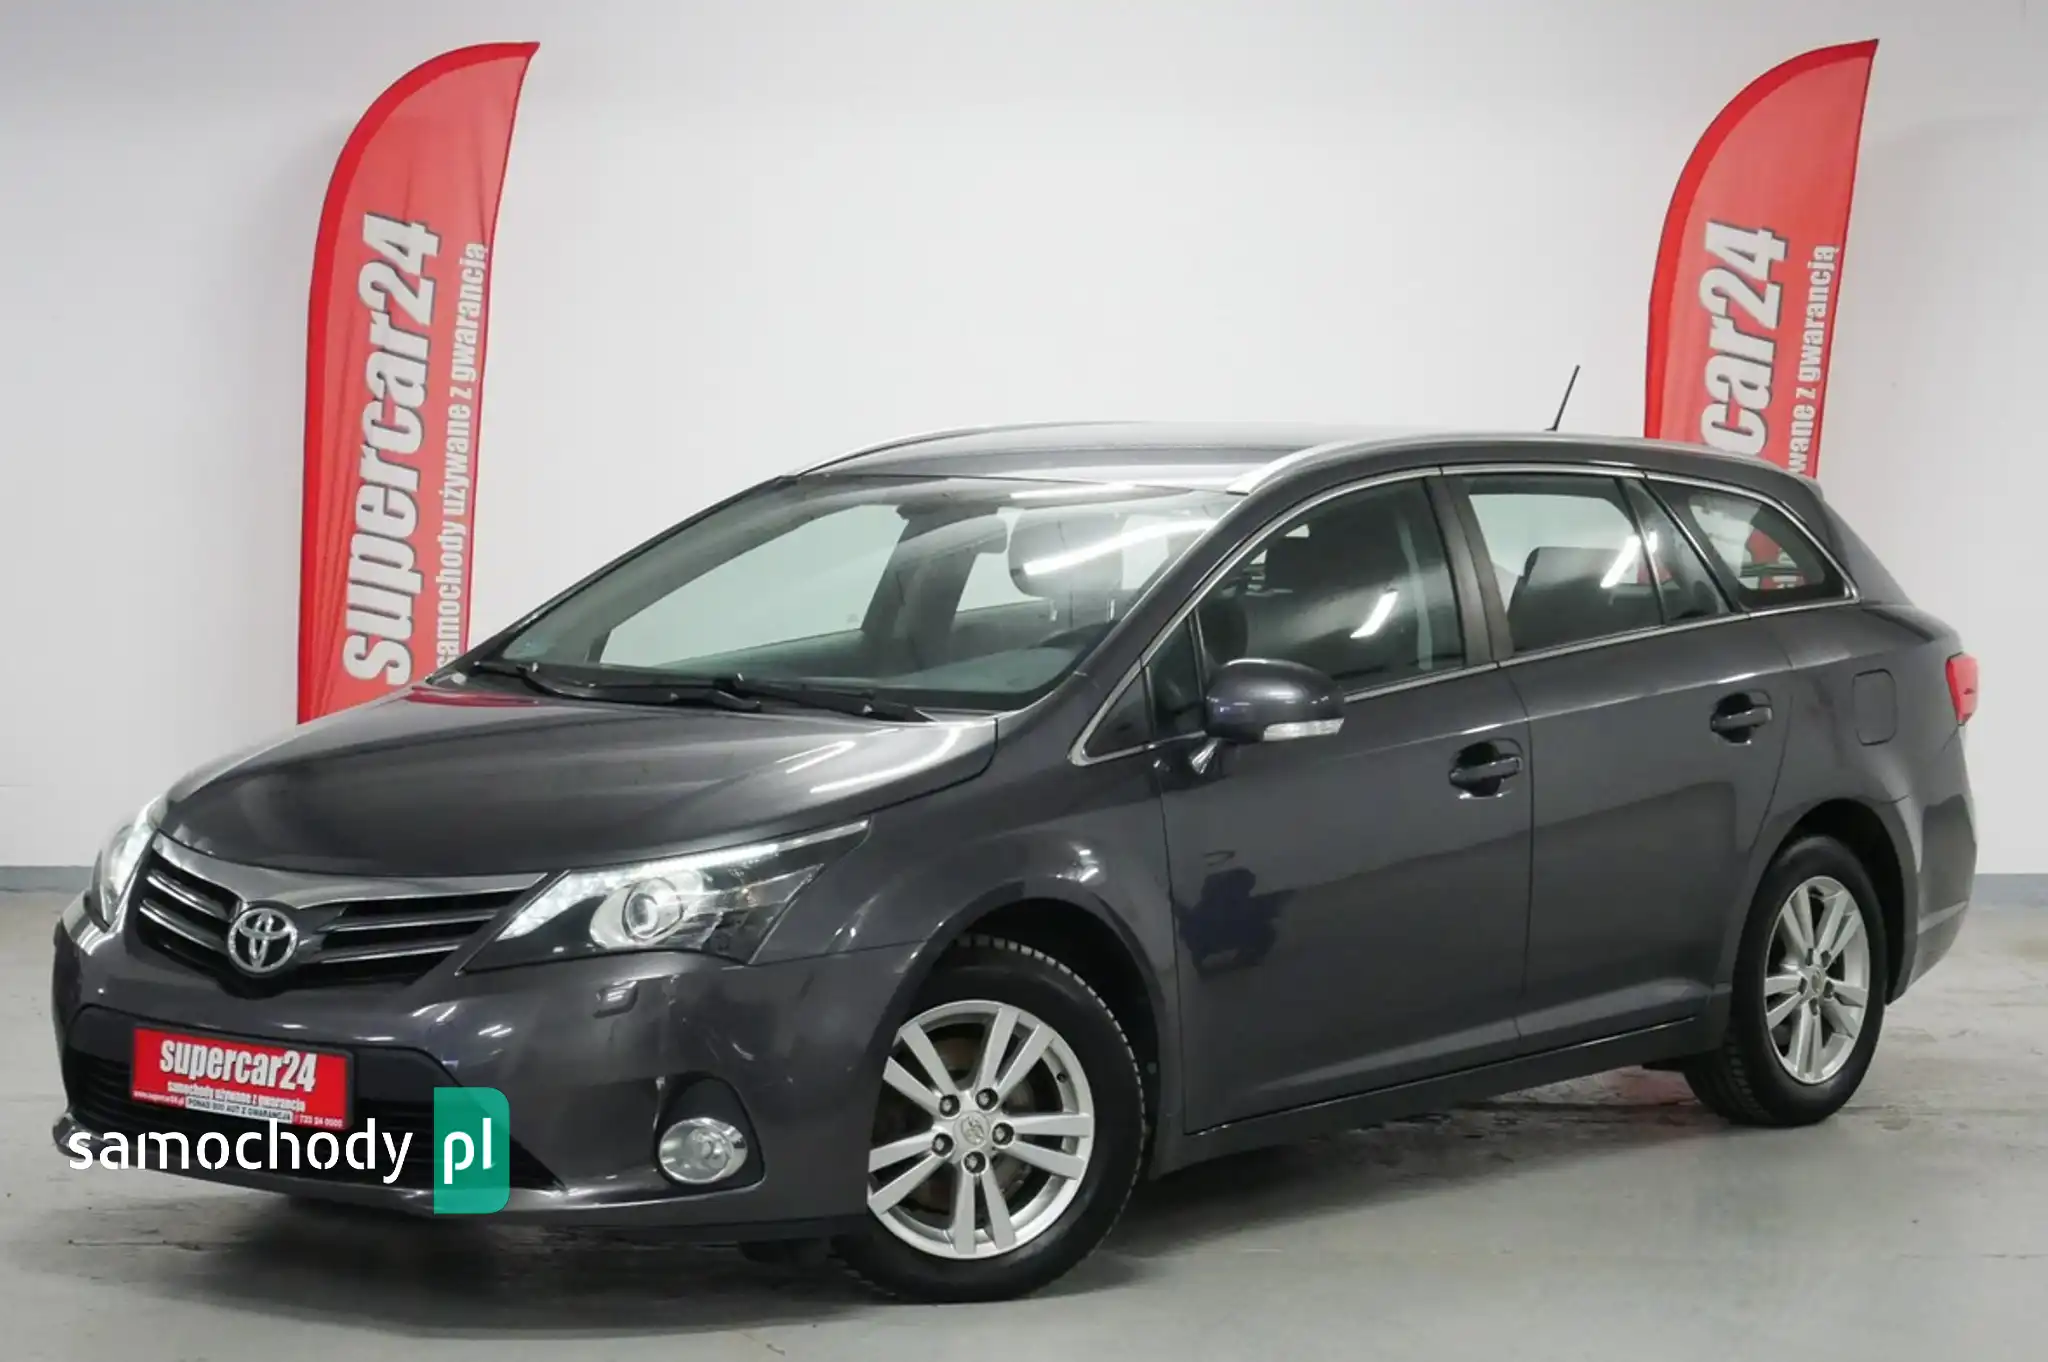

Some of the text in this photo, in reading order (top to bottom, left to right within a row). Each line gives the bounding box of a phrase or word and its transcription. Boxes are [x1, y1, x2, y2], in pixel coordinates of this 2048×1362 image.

[1797, 245, 1840, 382] gwarancją
[343, 212, 440, 686] supercar24
[450, 386, 472, 400] z
[1796, 386, 1817, 400] z
[439, 403, 470, 516] używane
[436, 521, 466, 669] samochody
[160, 1039, 317, 1093] supercar24
